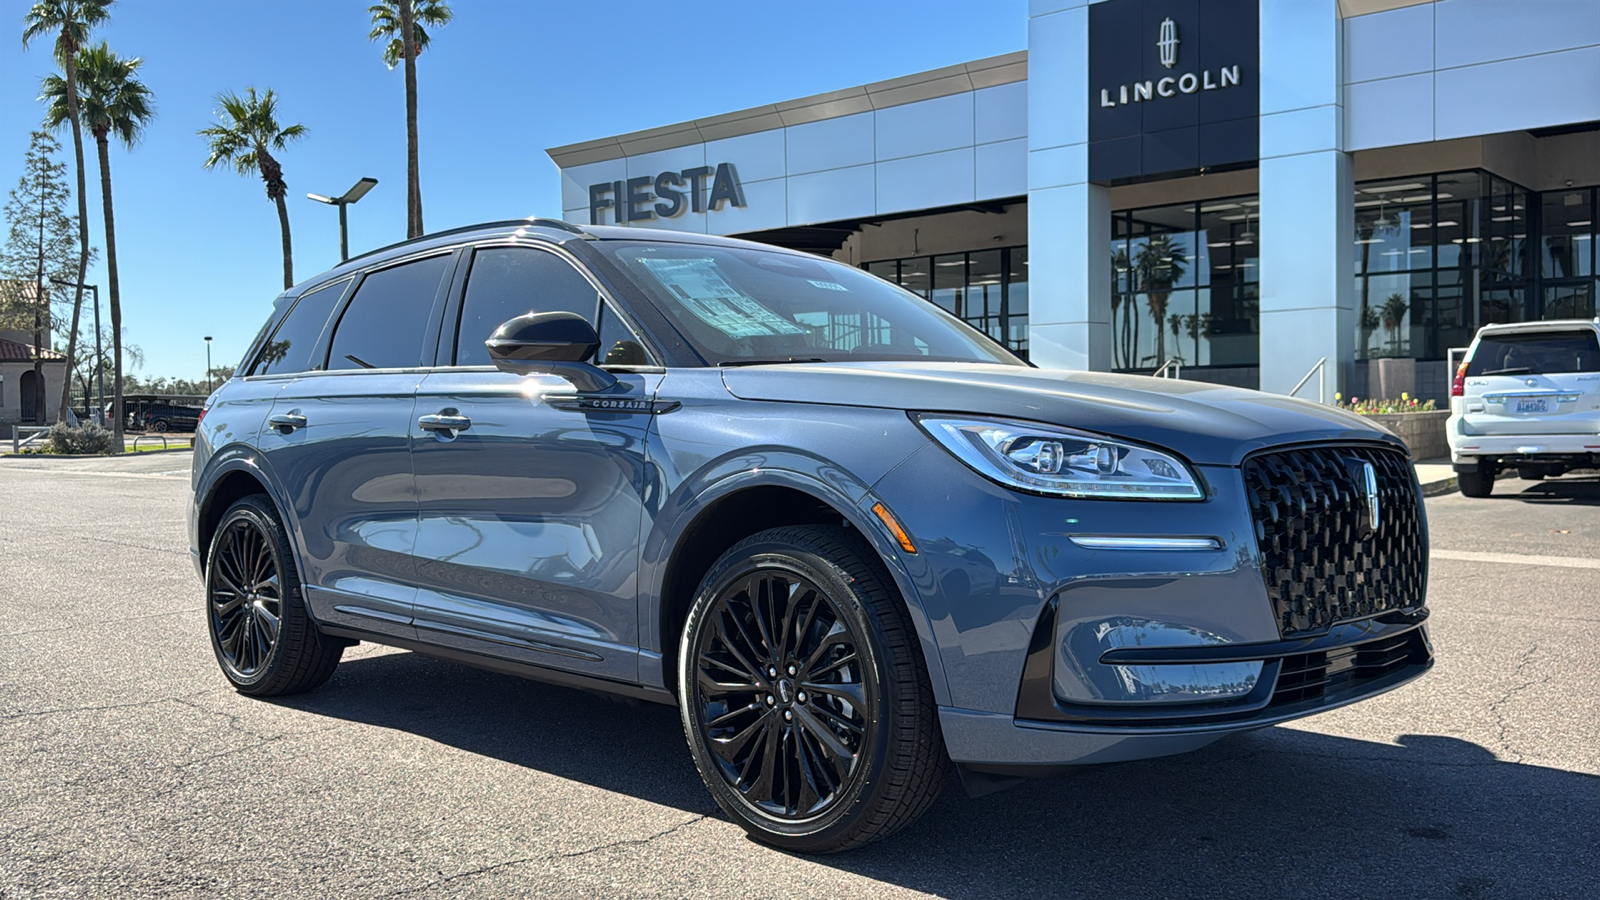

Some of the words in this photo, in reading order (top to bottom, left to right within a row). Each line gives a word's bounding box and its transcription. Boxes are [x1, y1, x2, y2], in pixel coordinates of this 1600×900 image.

[1101, 65, 1240, 107] LINCOLN
[589, 162, 747, 225] FIESTA
[592, 400, 647, 409] CORSAIR
